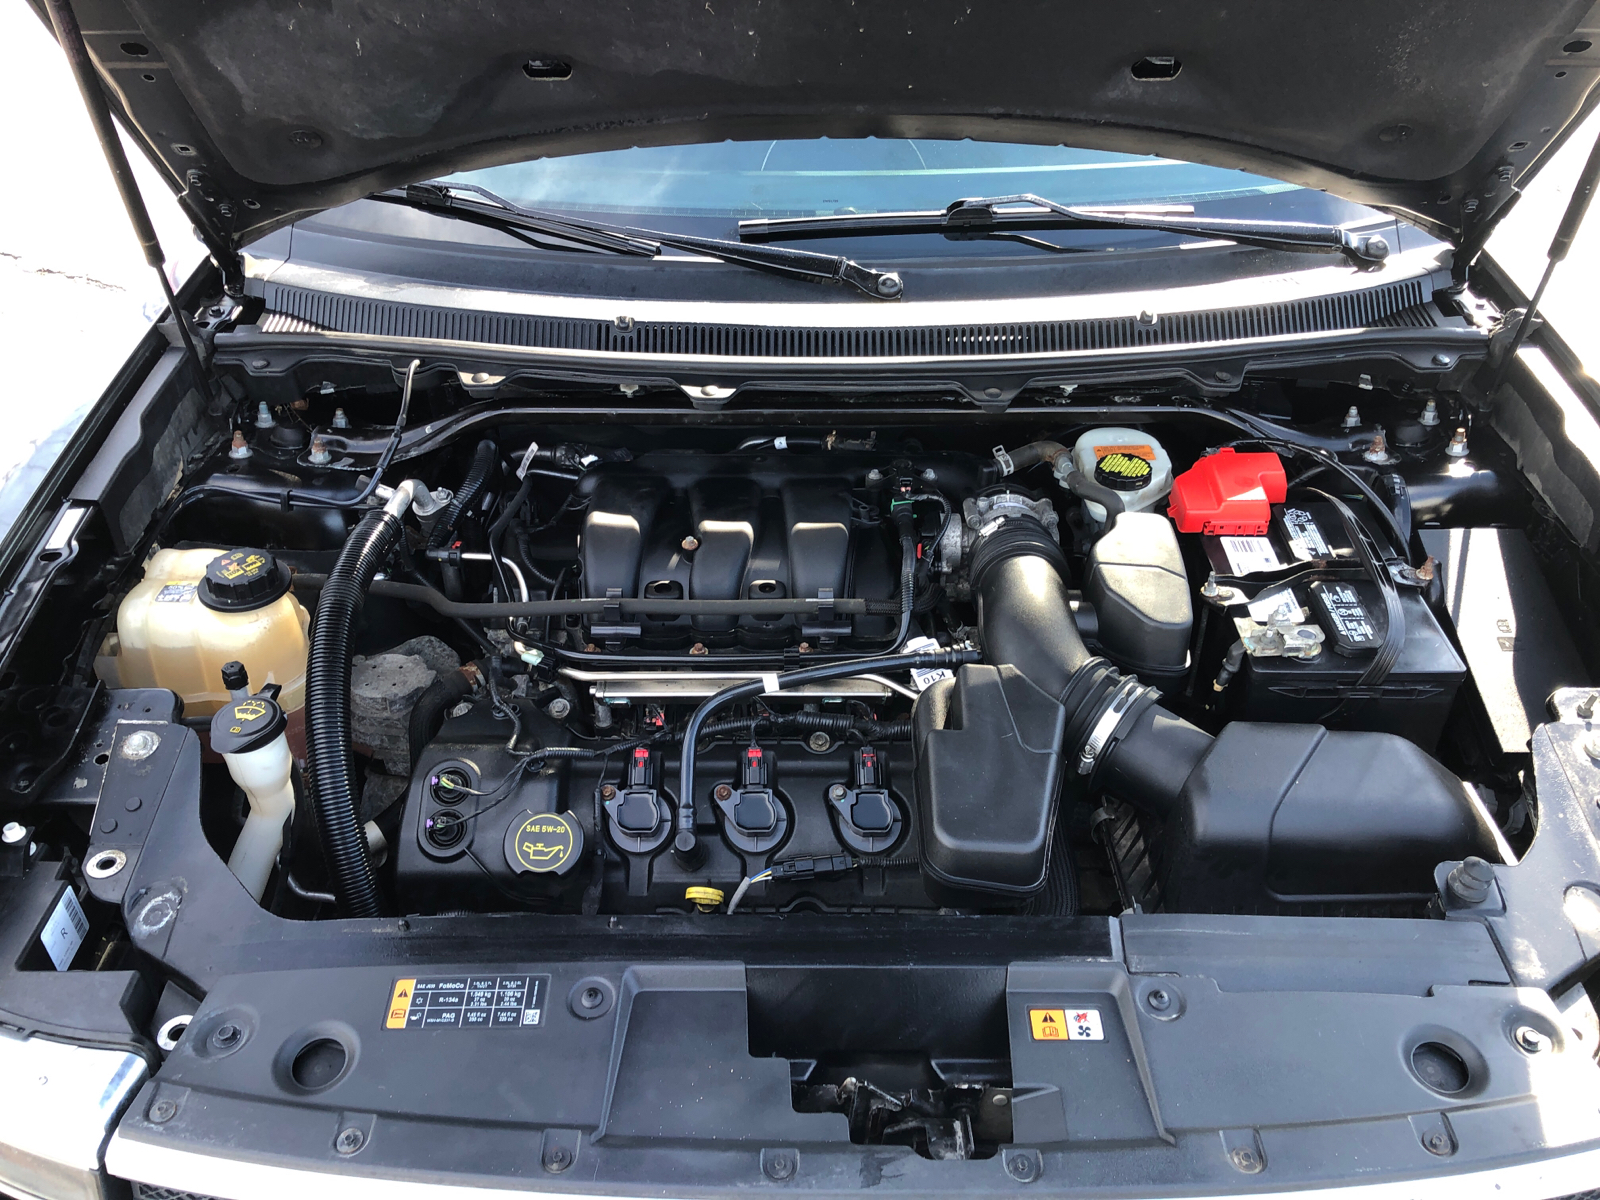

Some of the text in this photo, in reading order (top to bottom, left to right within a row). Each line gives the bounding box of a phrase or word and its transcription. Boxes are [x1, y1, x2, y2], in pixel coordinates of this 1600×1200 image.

[923, 670, 946, 685] K10
[526, 824, 566, 833] SAE 5W-20
[60, 927, 69, 939] R
